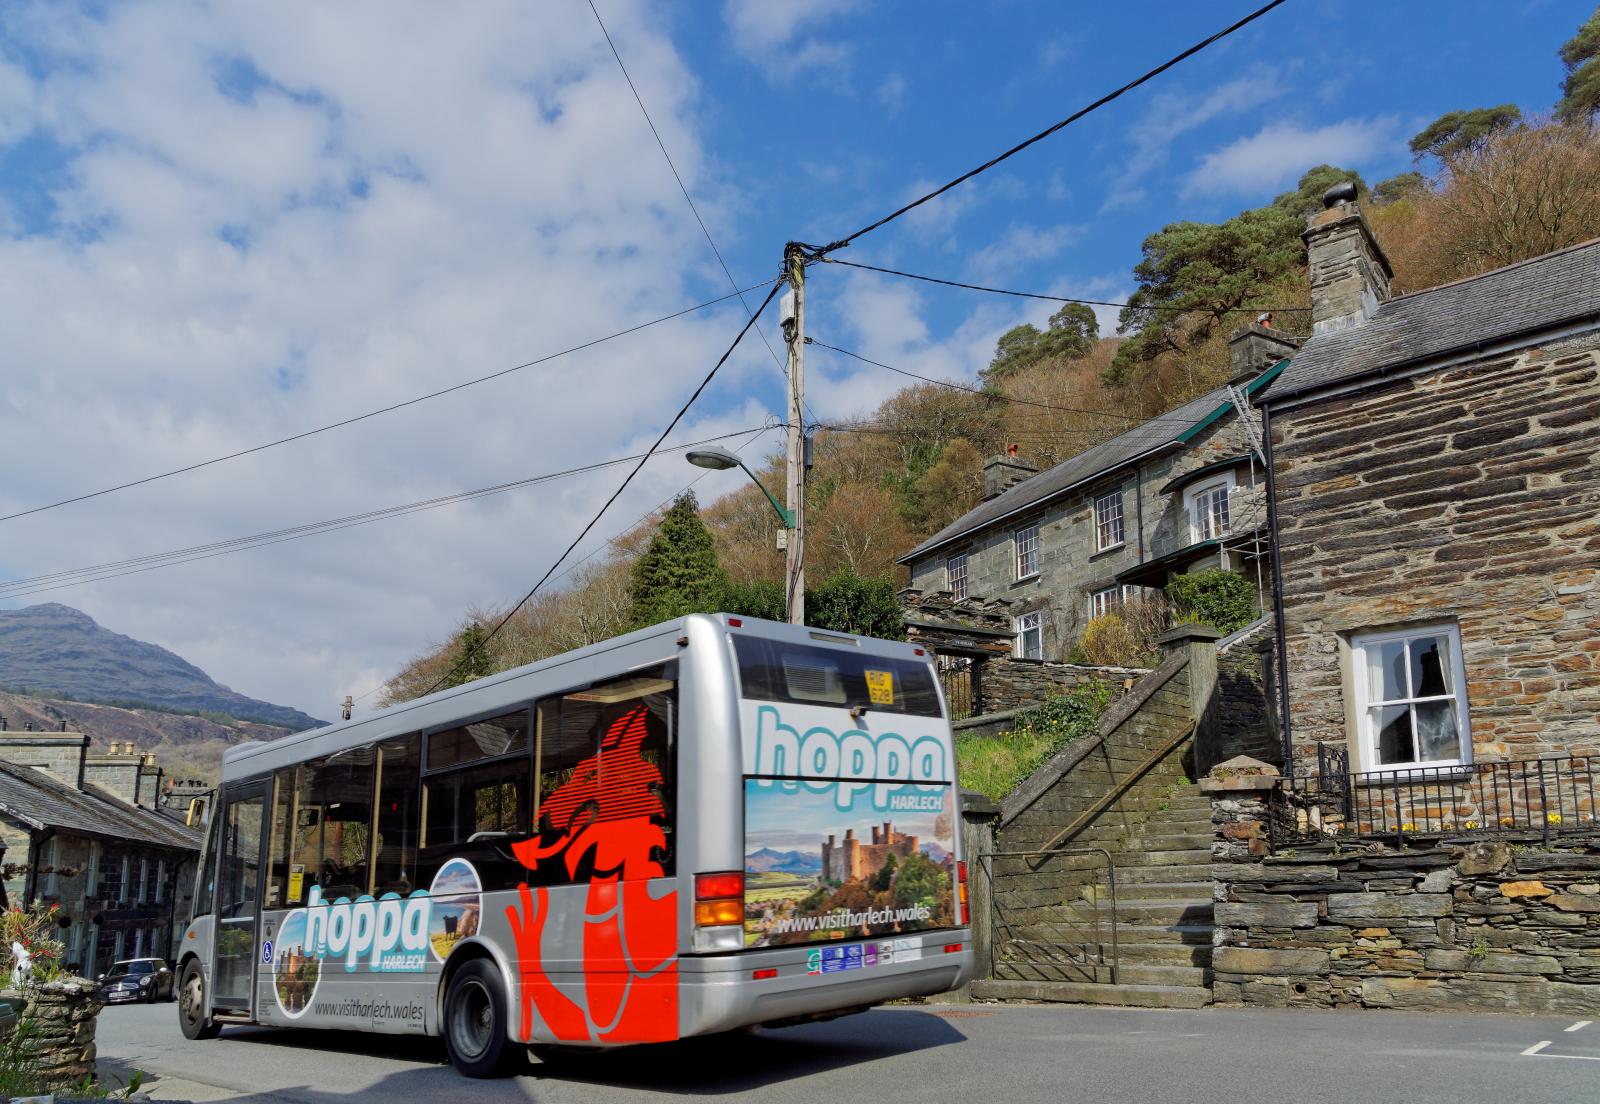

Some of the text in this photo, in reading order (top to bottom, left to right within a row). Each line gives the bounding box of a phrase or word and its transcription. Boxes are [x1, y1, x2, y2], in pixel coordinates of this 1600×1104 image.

[756, 706, 945, 810] hoppa
[890, 795, 943, 810] HARLECH
[304, 886, 430, 971] hoppa
[777, 903, 931, 934] www.visitharlech.wales
[382, 955, 426, 970] HARLECH
[315, 999, 423, 1020] www.visitharlech.wales
